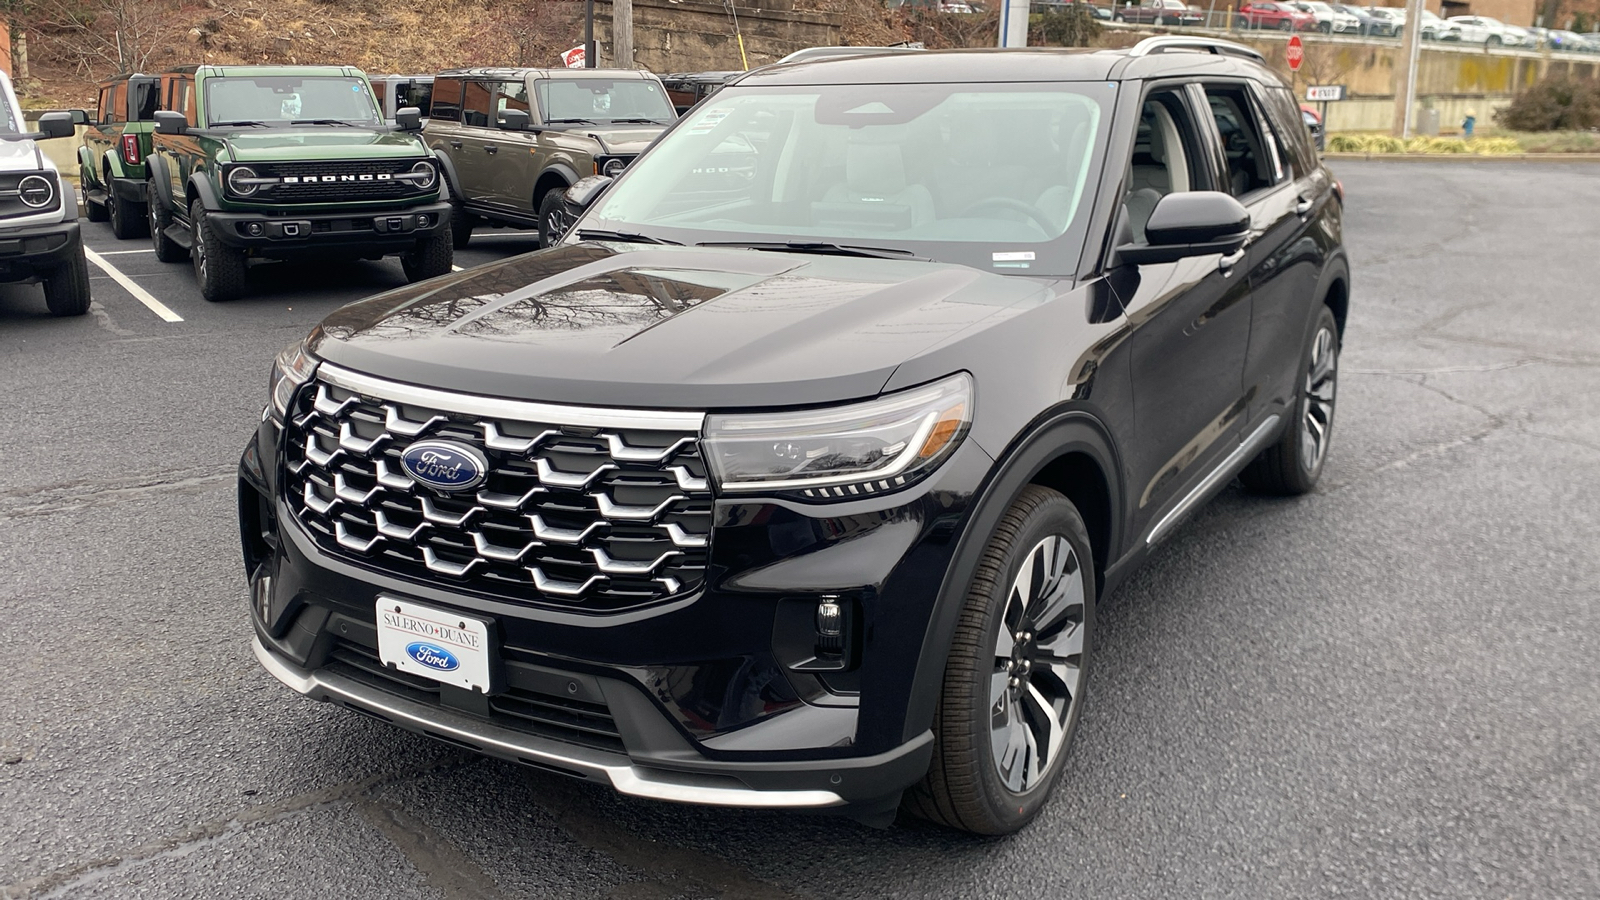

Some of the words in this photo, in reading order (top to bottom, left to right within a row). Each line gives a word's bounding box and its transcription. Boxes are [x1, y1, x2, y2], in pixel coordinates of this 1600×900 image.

[1287, 45, 1302, 60] STOP
[283, 173, 391, 183] BRONCO
[416, 450, 462, 480] Ford
[384, 613, 434, 635] SALERNO
[440, 627, 479, 648] DUANE
[416, 645, 449, 668] Ford
